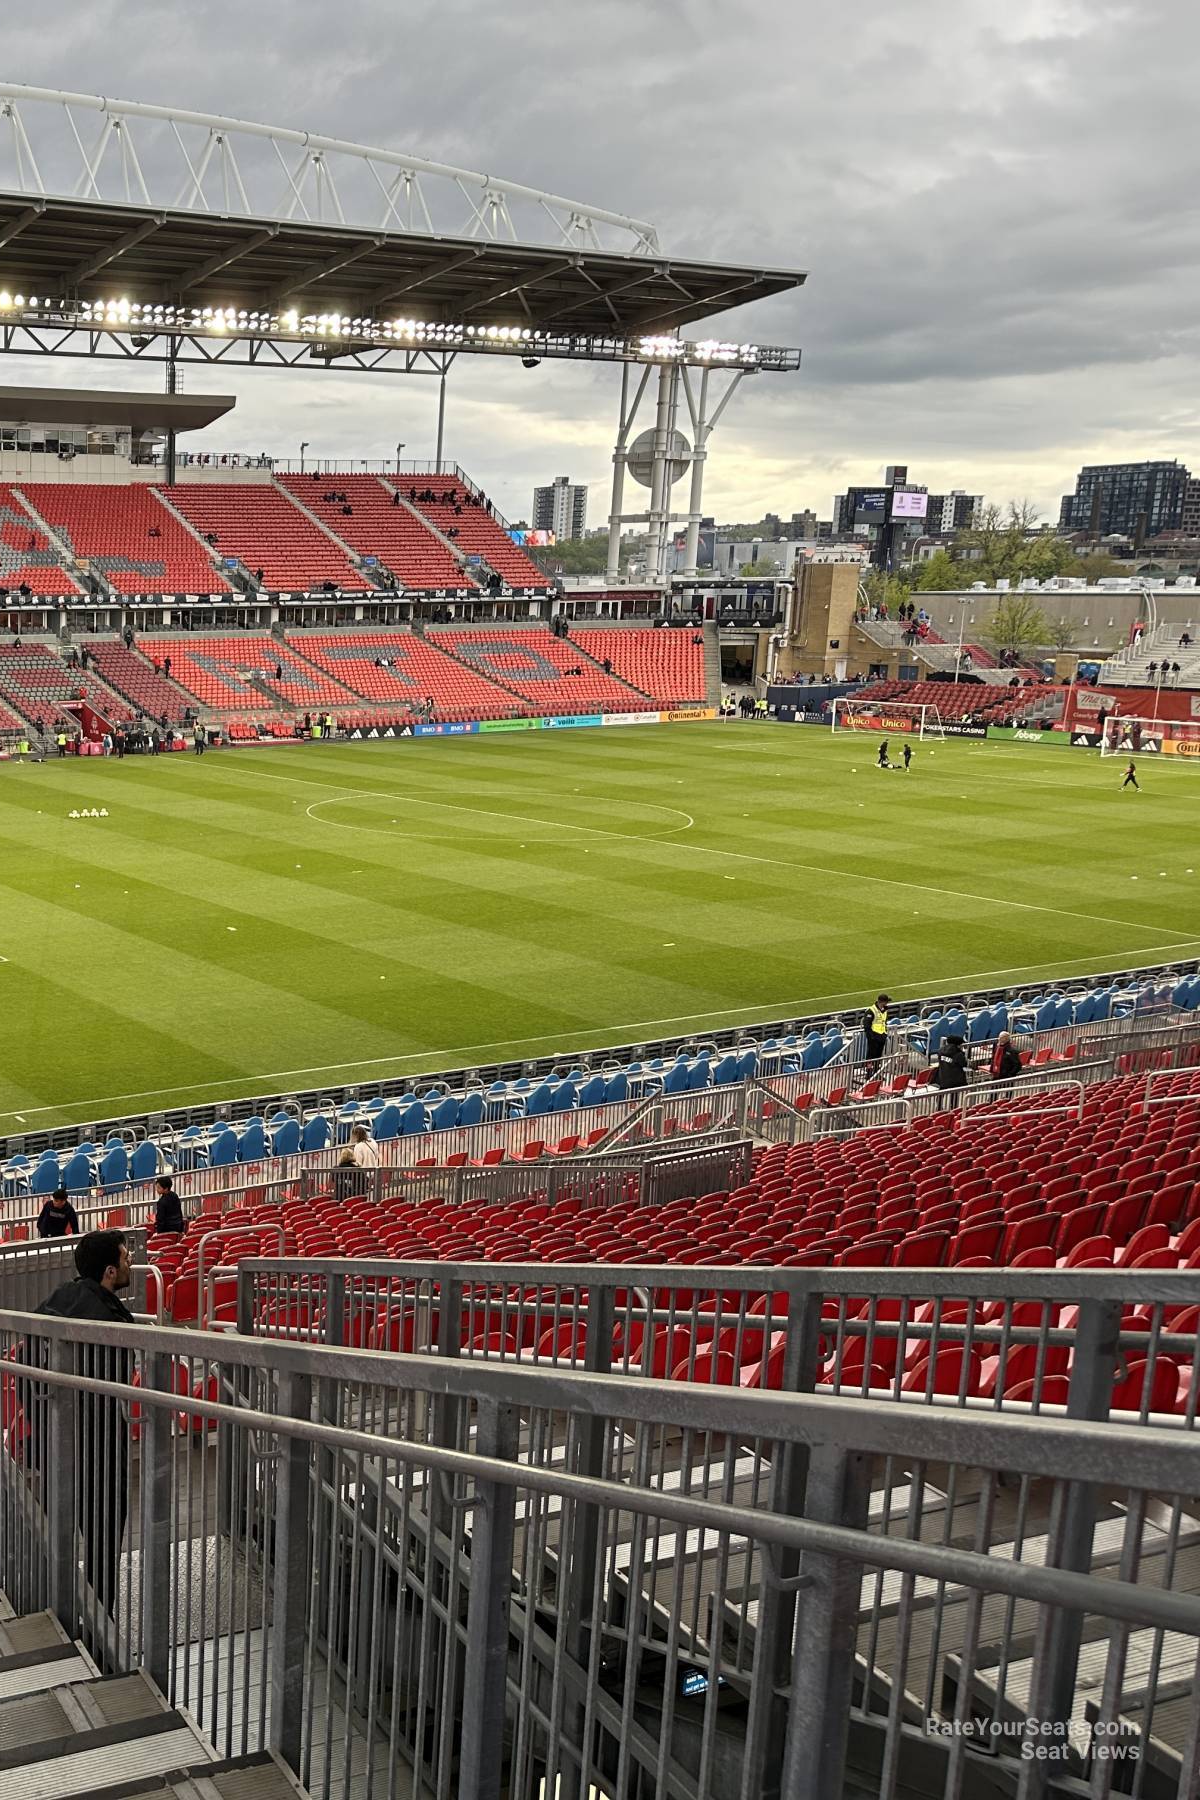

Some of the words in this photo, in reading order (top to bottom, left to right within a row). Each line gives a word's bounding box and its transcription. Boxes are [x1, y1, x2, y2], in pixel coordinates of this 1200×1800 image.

[668, 711, 702, 722] Continental
[847, 716, 870, 725] Unico
[882, 719, 905, 728] Unico
[962, 727, 985, 735] CASINO
